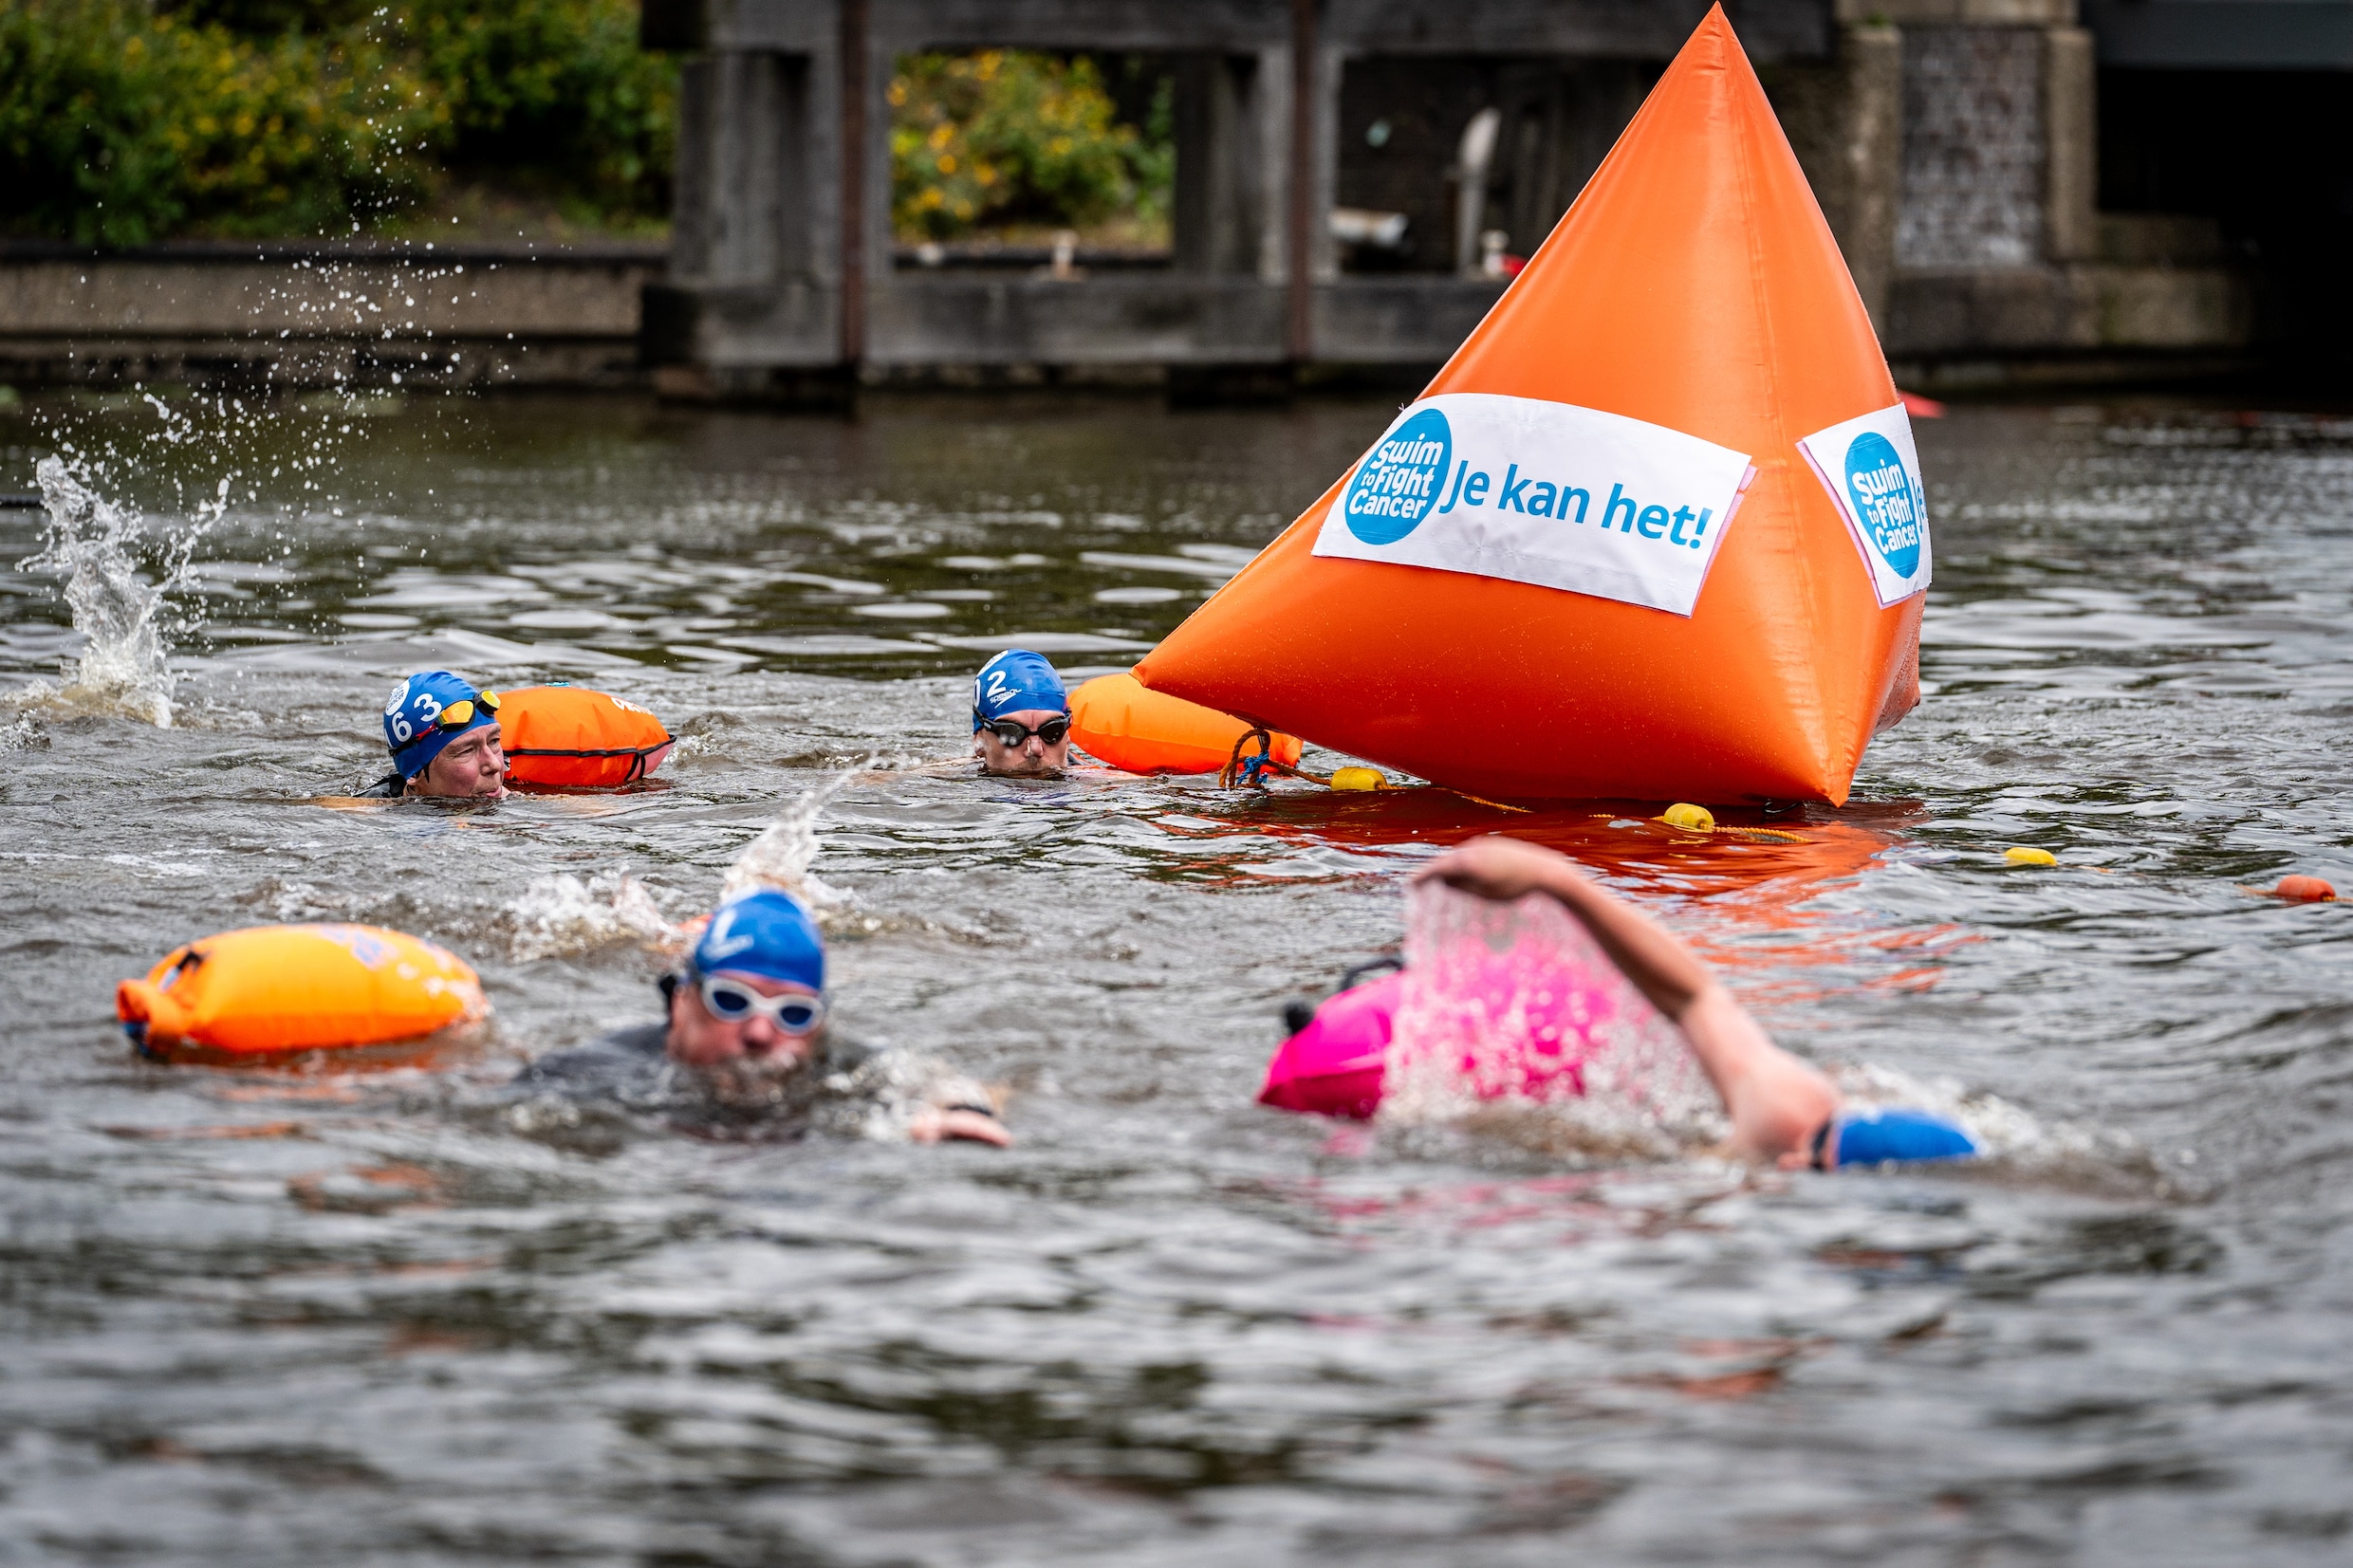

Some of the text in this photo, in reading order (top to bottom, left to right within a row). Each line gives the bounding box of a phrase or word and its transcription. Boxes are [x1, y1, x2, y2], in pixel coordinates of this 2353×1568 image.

[1361, 464, 1436, 498] to Fight
[1349, 488, 1428, 520] Cancer
[1438, 459, 1714, 550] Je kan het!
[1866, 491, 1914, 529] to Fight
[1874, 524, 1918, 555] Cancer
